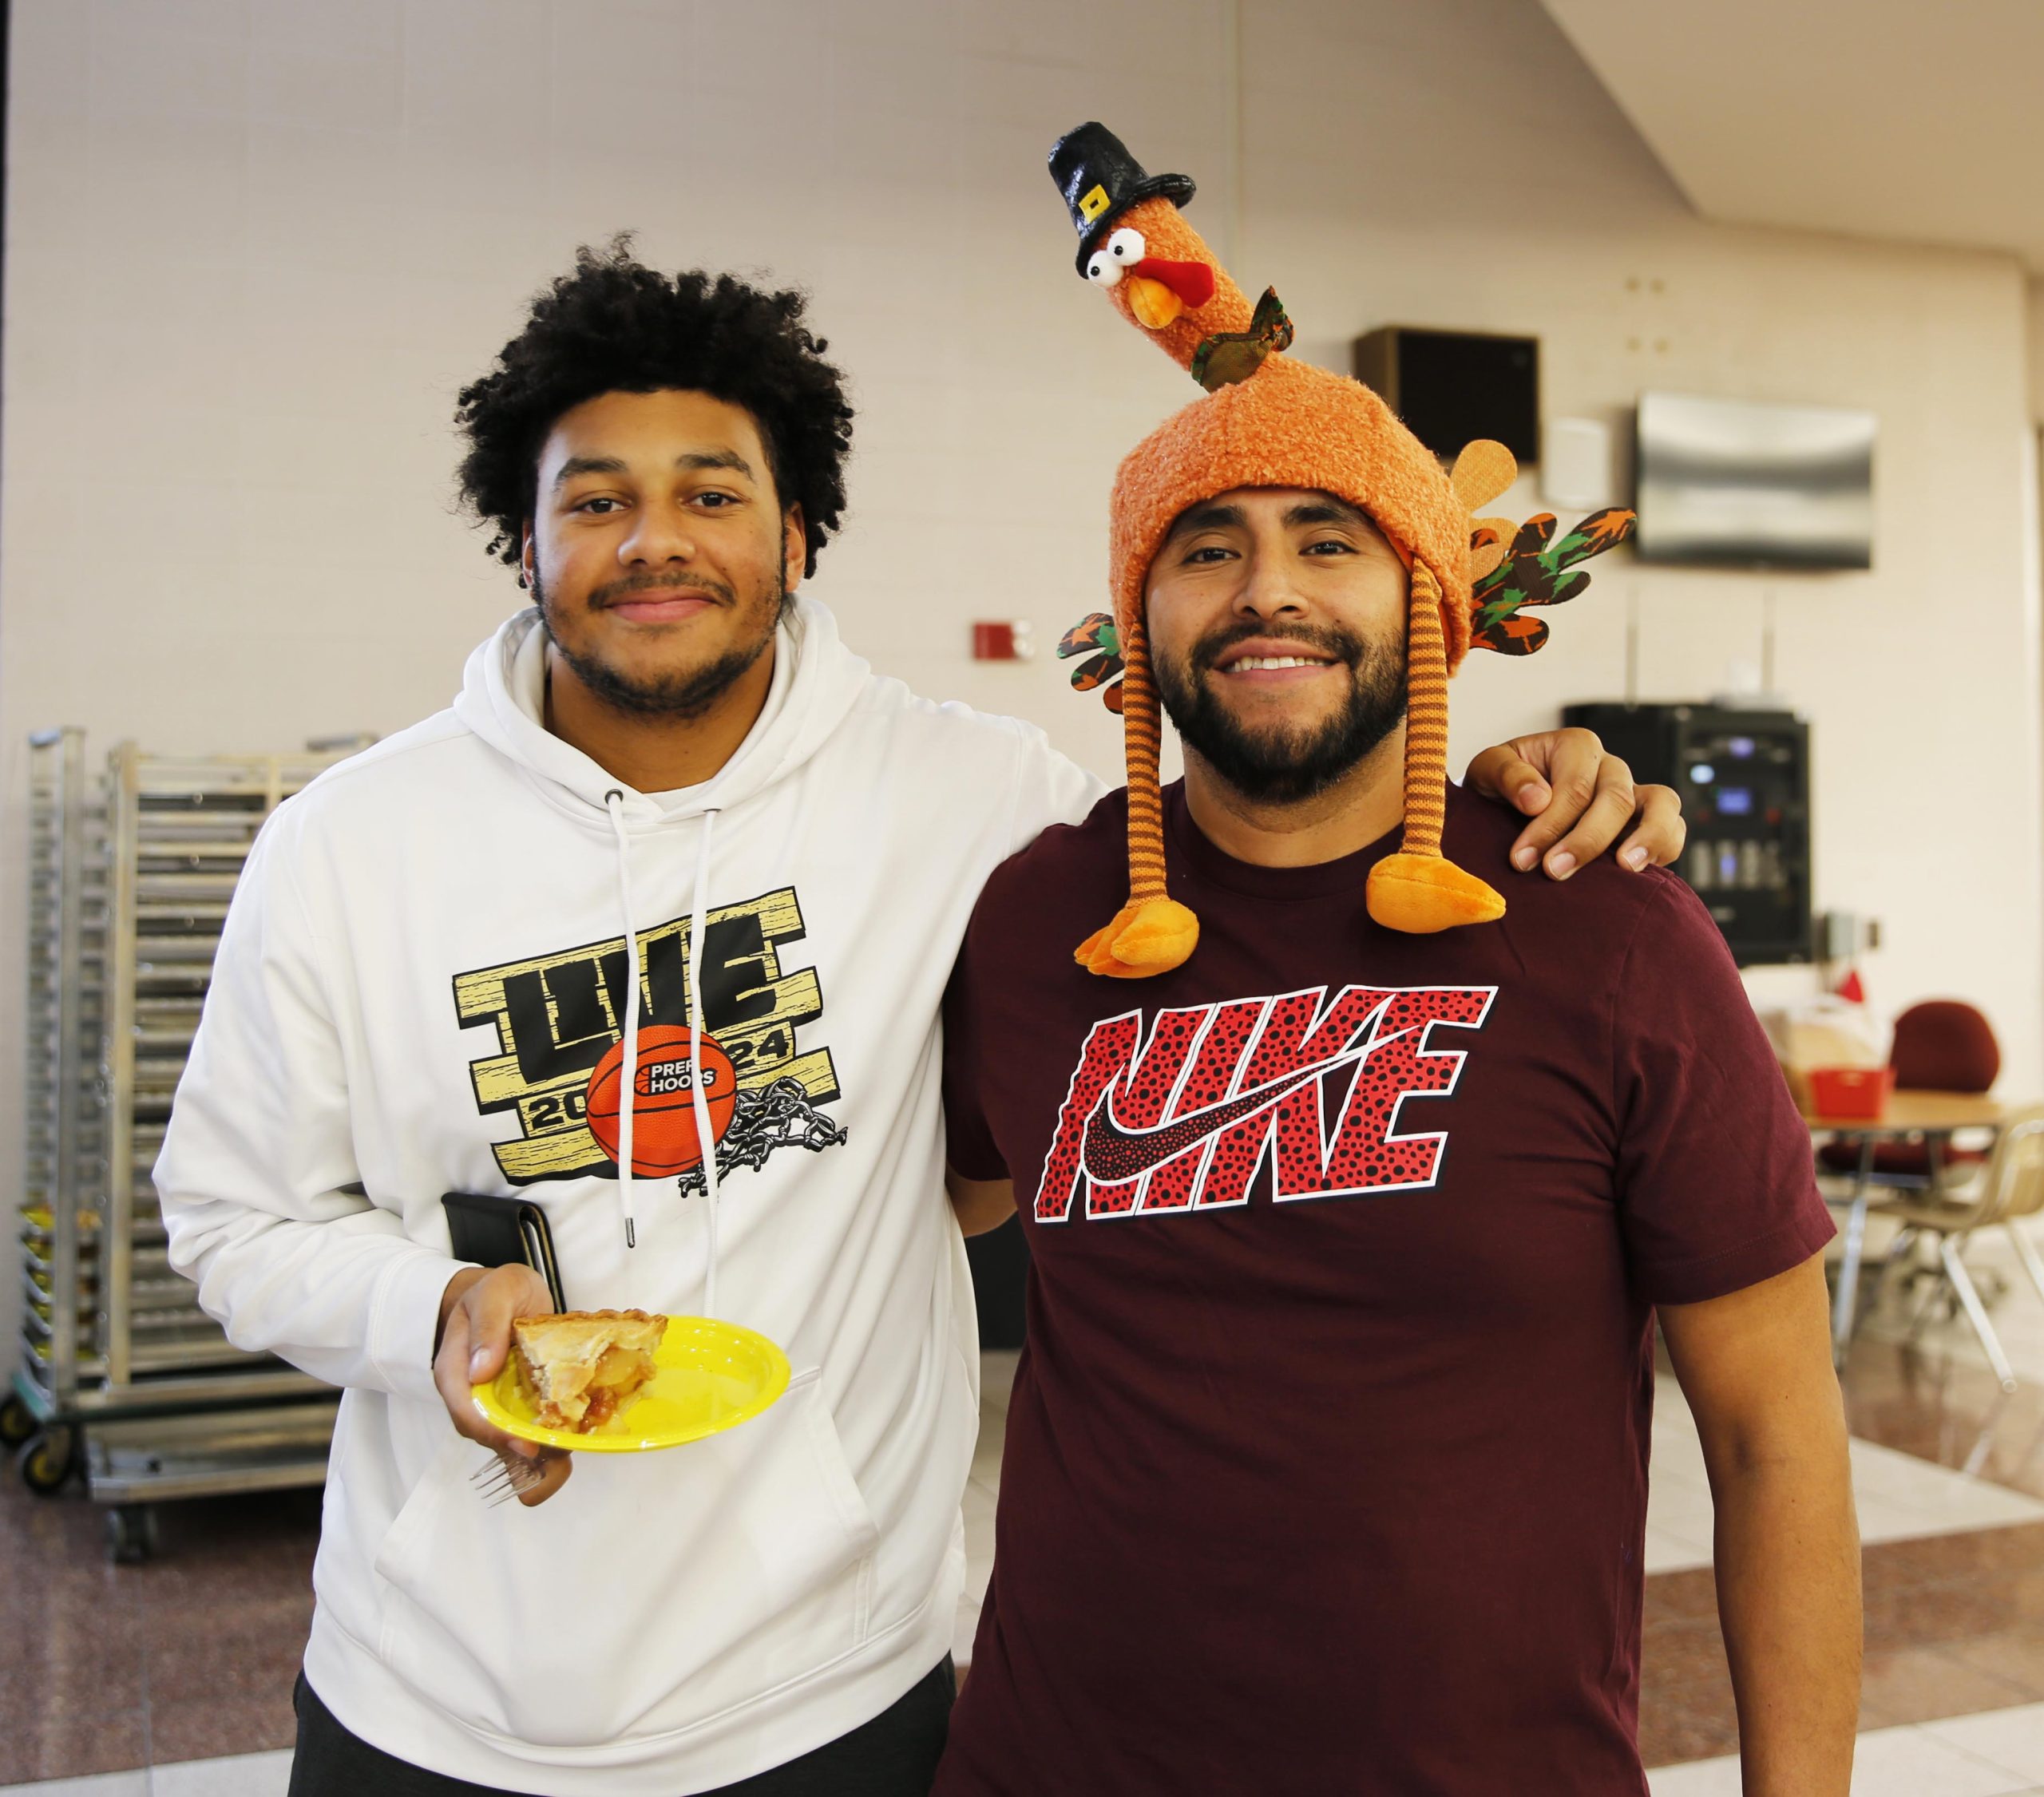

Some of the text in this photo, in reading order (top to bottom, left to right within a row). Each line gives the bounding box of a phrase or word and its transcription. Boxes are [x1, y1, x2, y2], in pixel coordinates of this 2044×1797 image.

[501, 912, 778, 1086] LIVE
[528, 1028, 790, 1130] 20 24
[651, 1071, 715, 1093] HOOS
[1034, 984, 1499, 1223] NIKE
